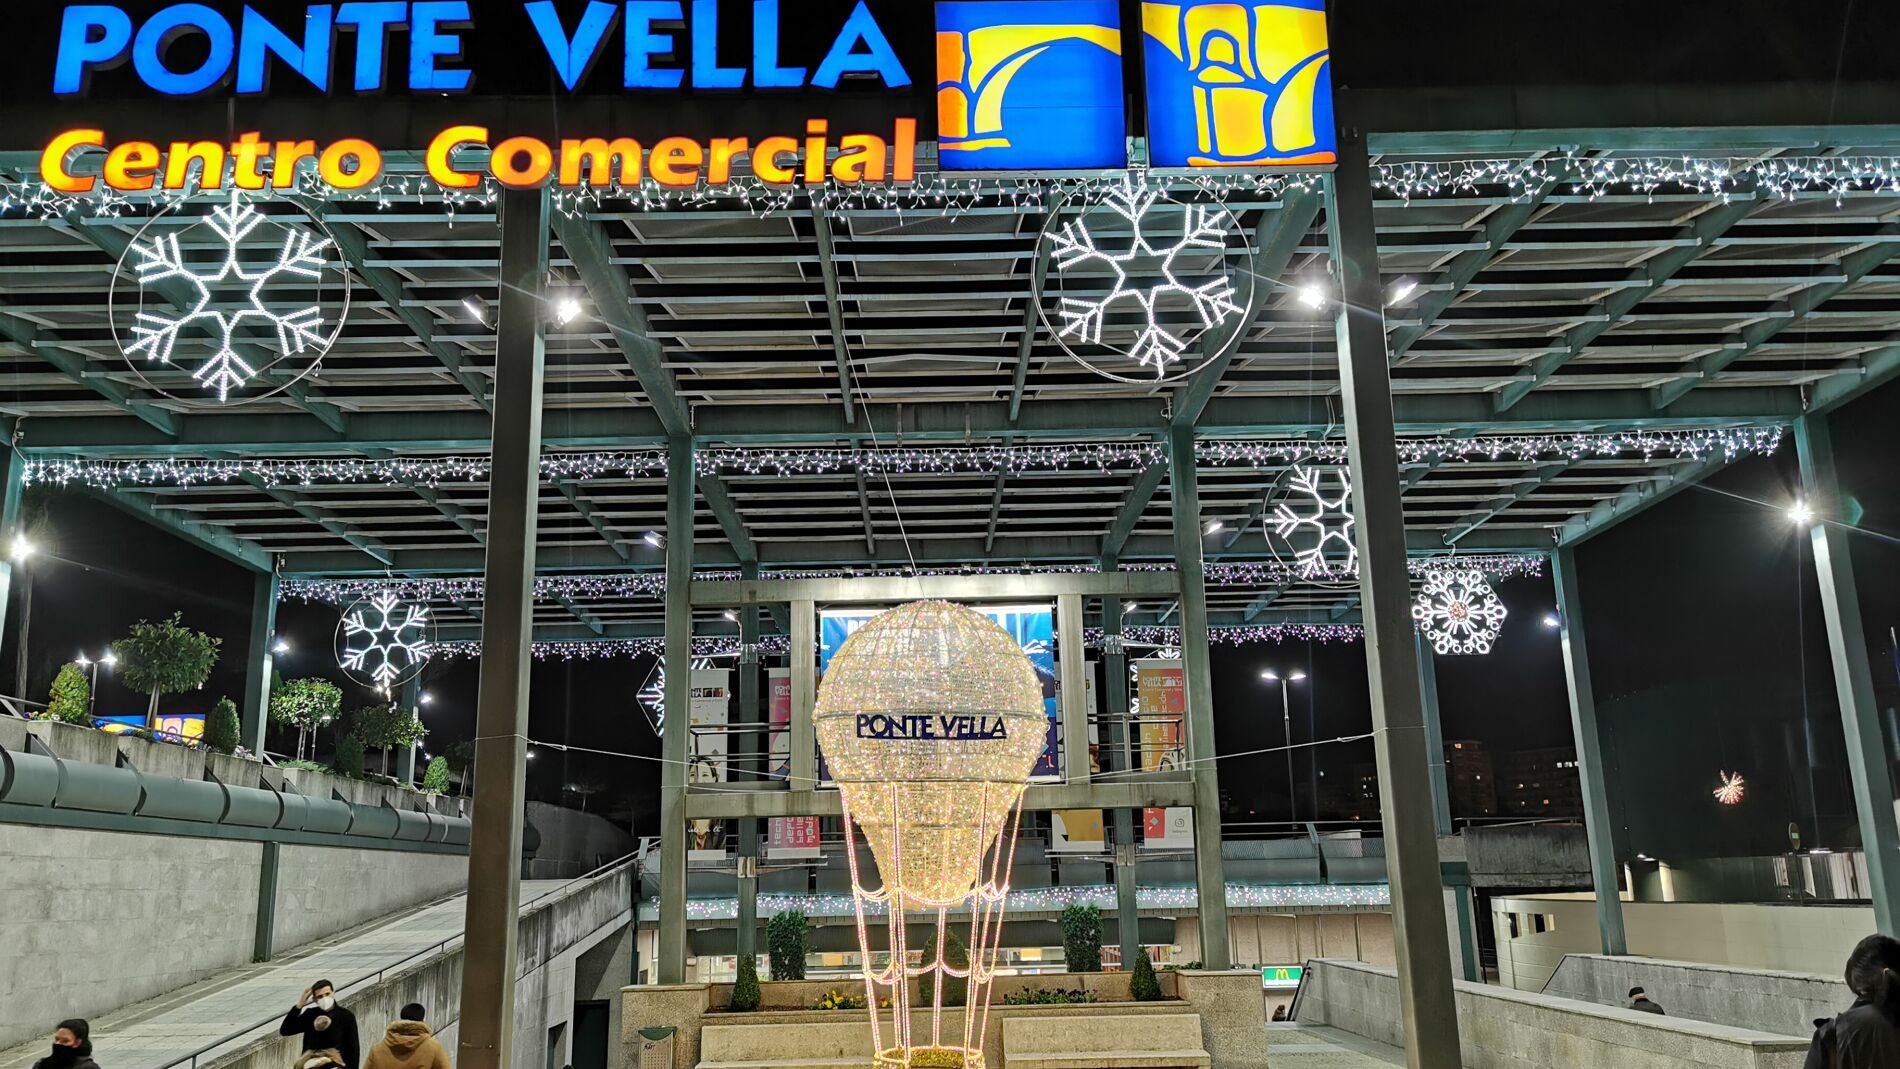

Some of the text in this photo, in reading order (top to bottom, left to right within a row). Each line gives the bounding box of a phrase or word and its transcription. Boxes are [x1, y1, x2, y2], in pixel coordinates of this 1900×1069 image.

[53, 0, 912, 95] PONTE VELLA
[39, 117, 917, 191] Centro Comercial
[857, 714, 1008, 740] PONTE VELLA
